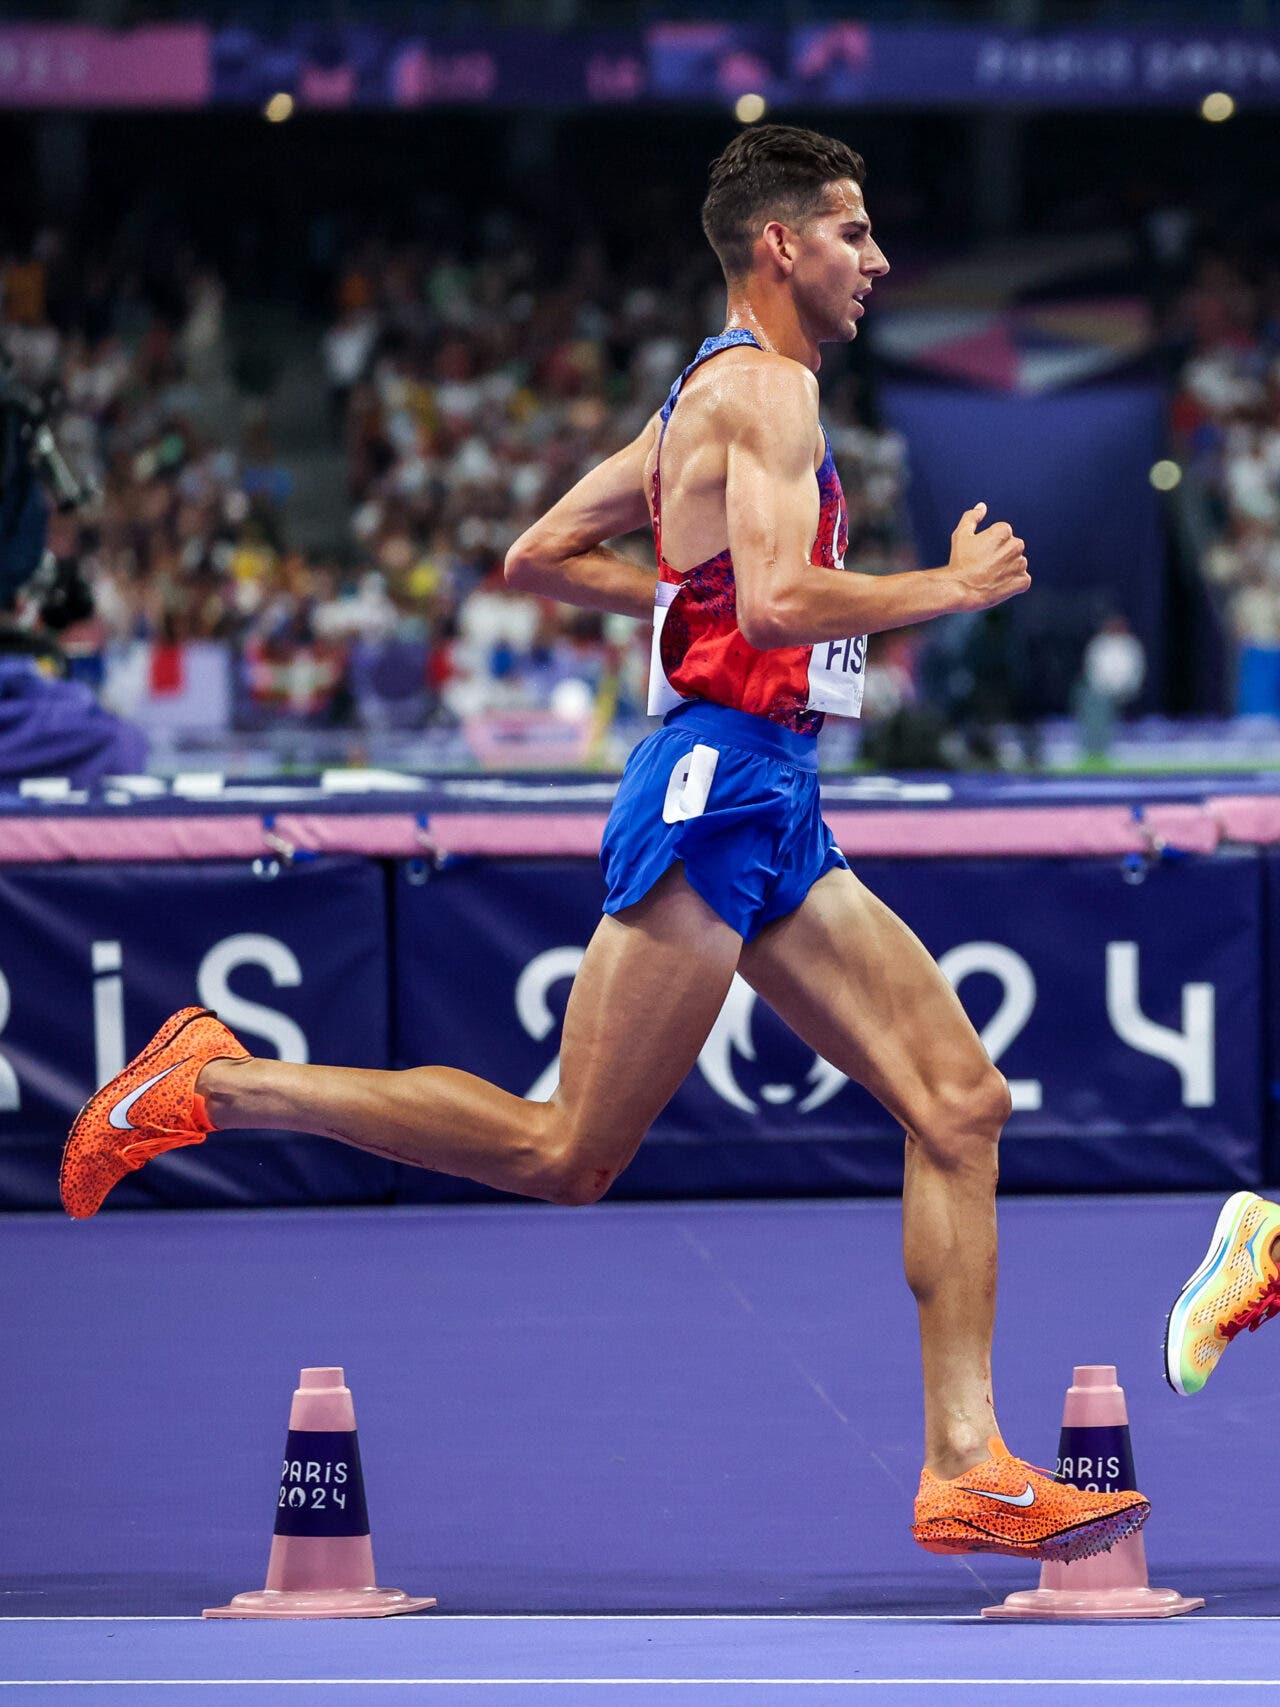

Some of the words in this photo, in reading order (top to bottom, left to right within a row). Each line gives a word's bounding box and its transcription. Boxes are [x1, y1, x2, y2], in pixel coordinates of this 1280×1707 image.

[825, 635, 867, 675] FIS
[0, 932, 309, 1112] iS
[278, 1486, 346, 1510] 2024
